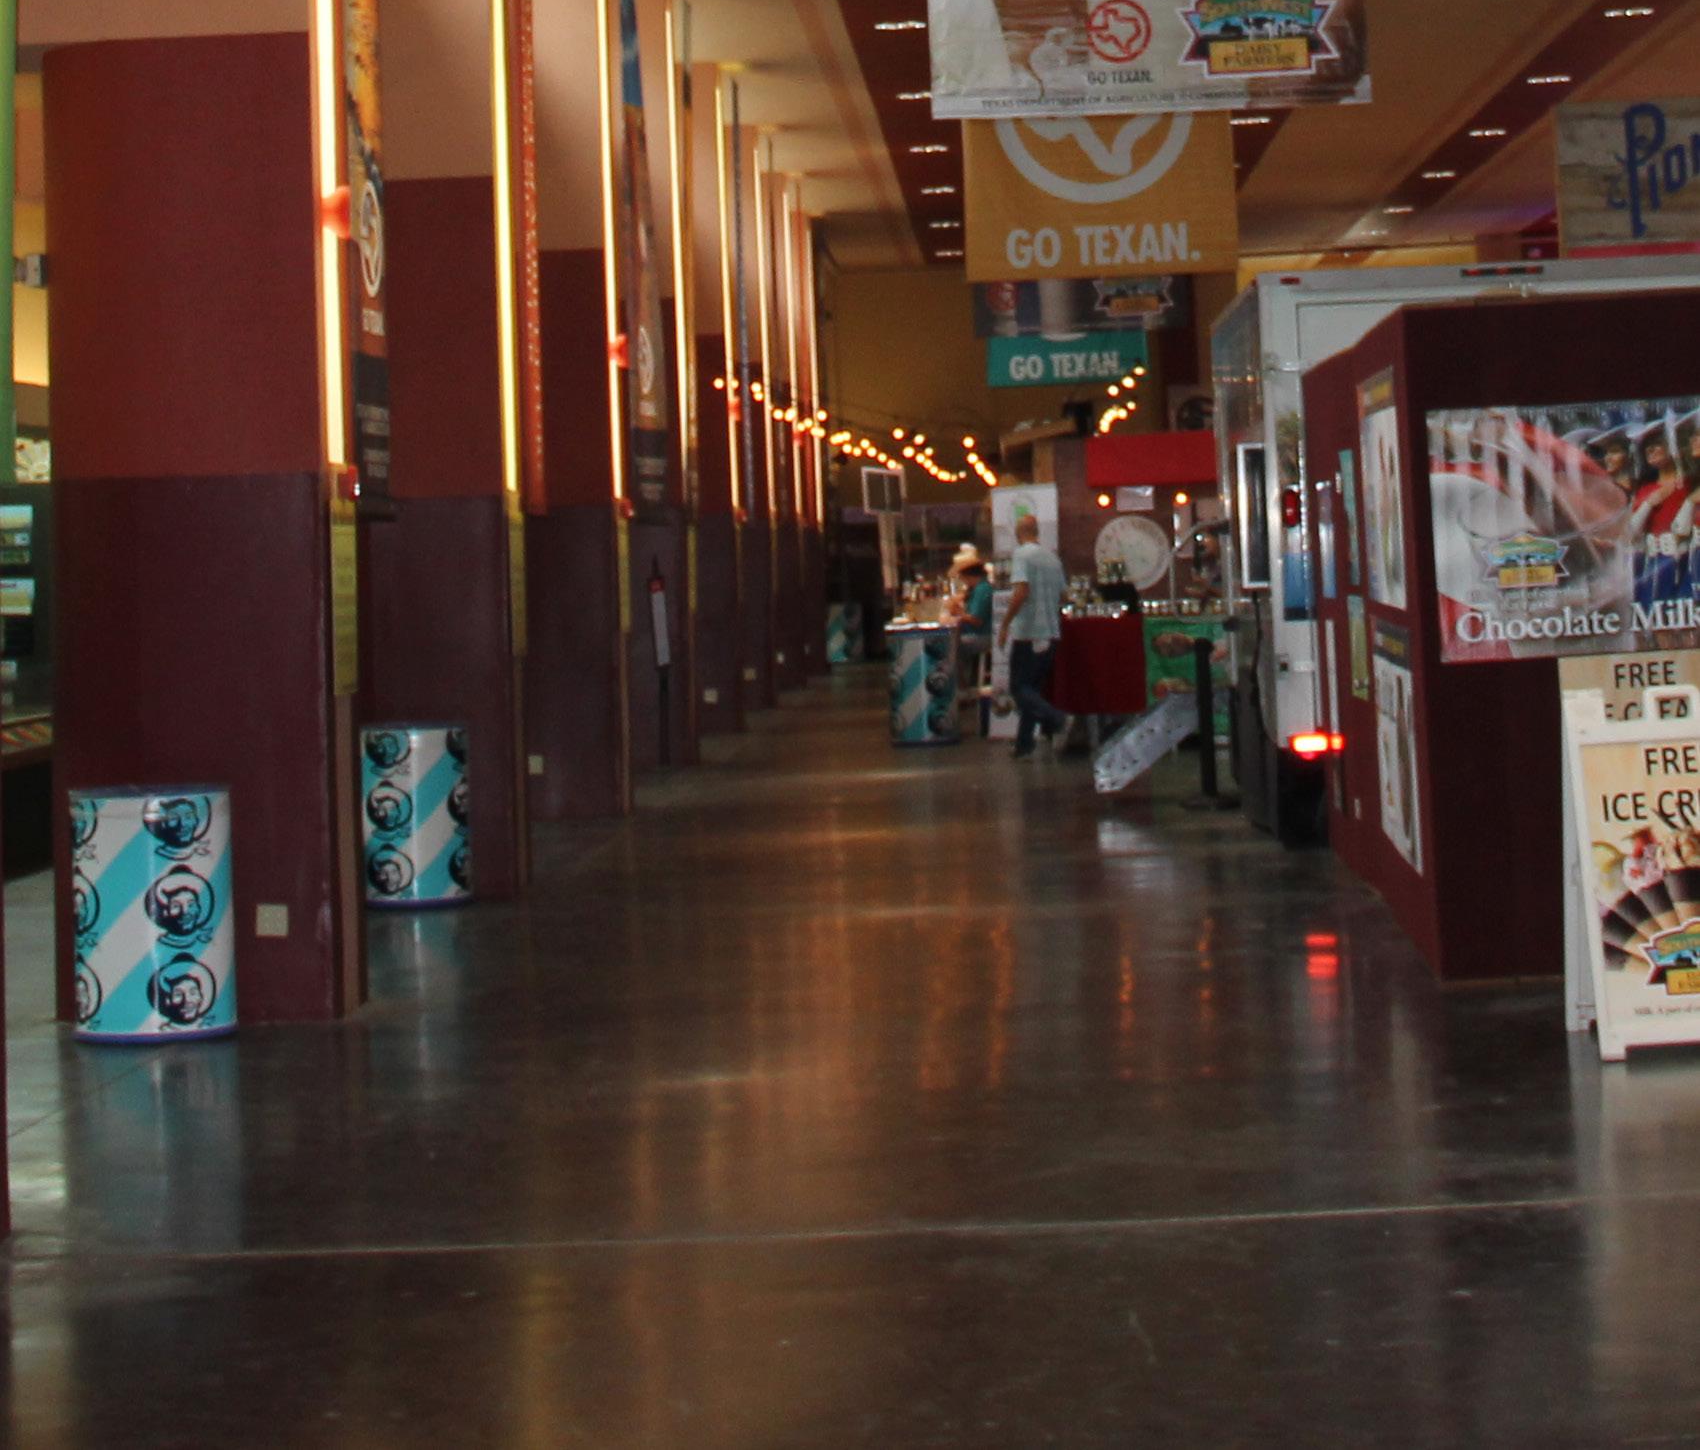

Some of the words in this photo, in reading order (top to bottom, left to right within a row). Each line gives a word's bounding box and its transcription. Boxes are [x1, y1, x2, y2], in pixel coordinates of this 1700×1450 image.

[1087, 73, 1105, 85] GO
[1006, 227, 1062, 270] GO
[1074, 222, 1201, 266] TEXAN.
[1009, 354, 1044, 381] GO
[1455, 605, 1621, 644] Chocolate
[1614, 659, 1677, 689] FREE
[1602, 791, 1648, 823] ICE
[1658, 788, 1700, 820] CR
